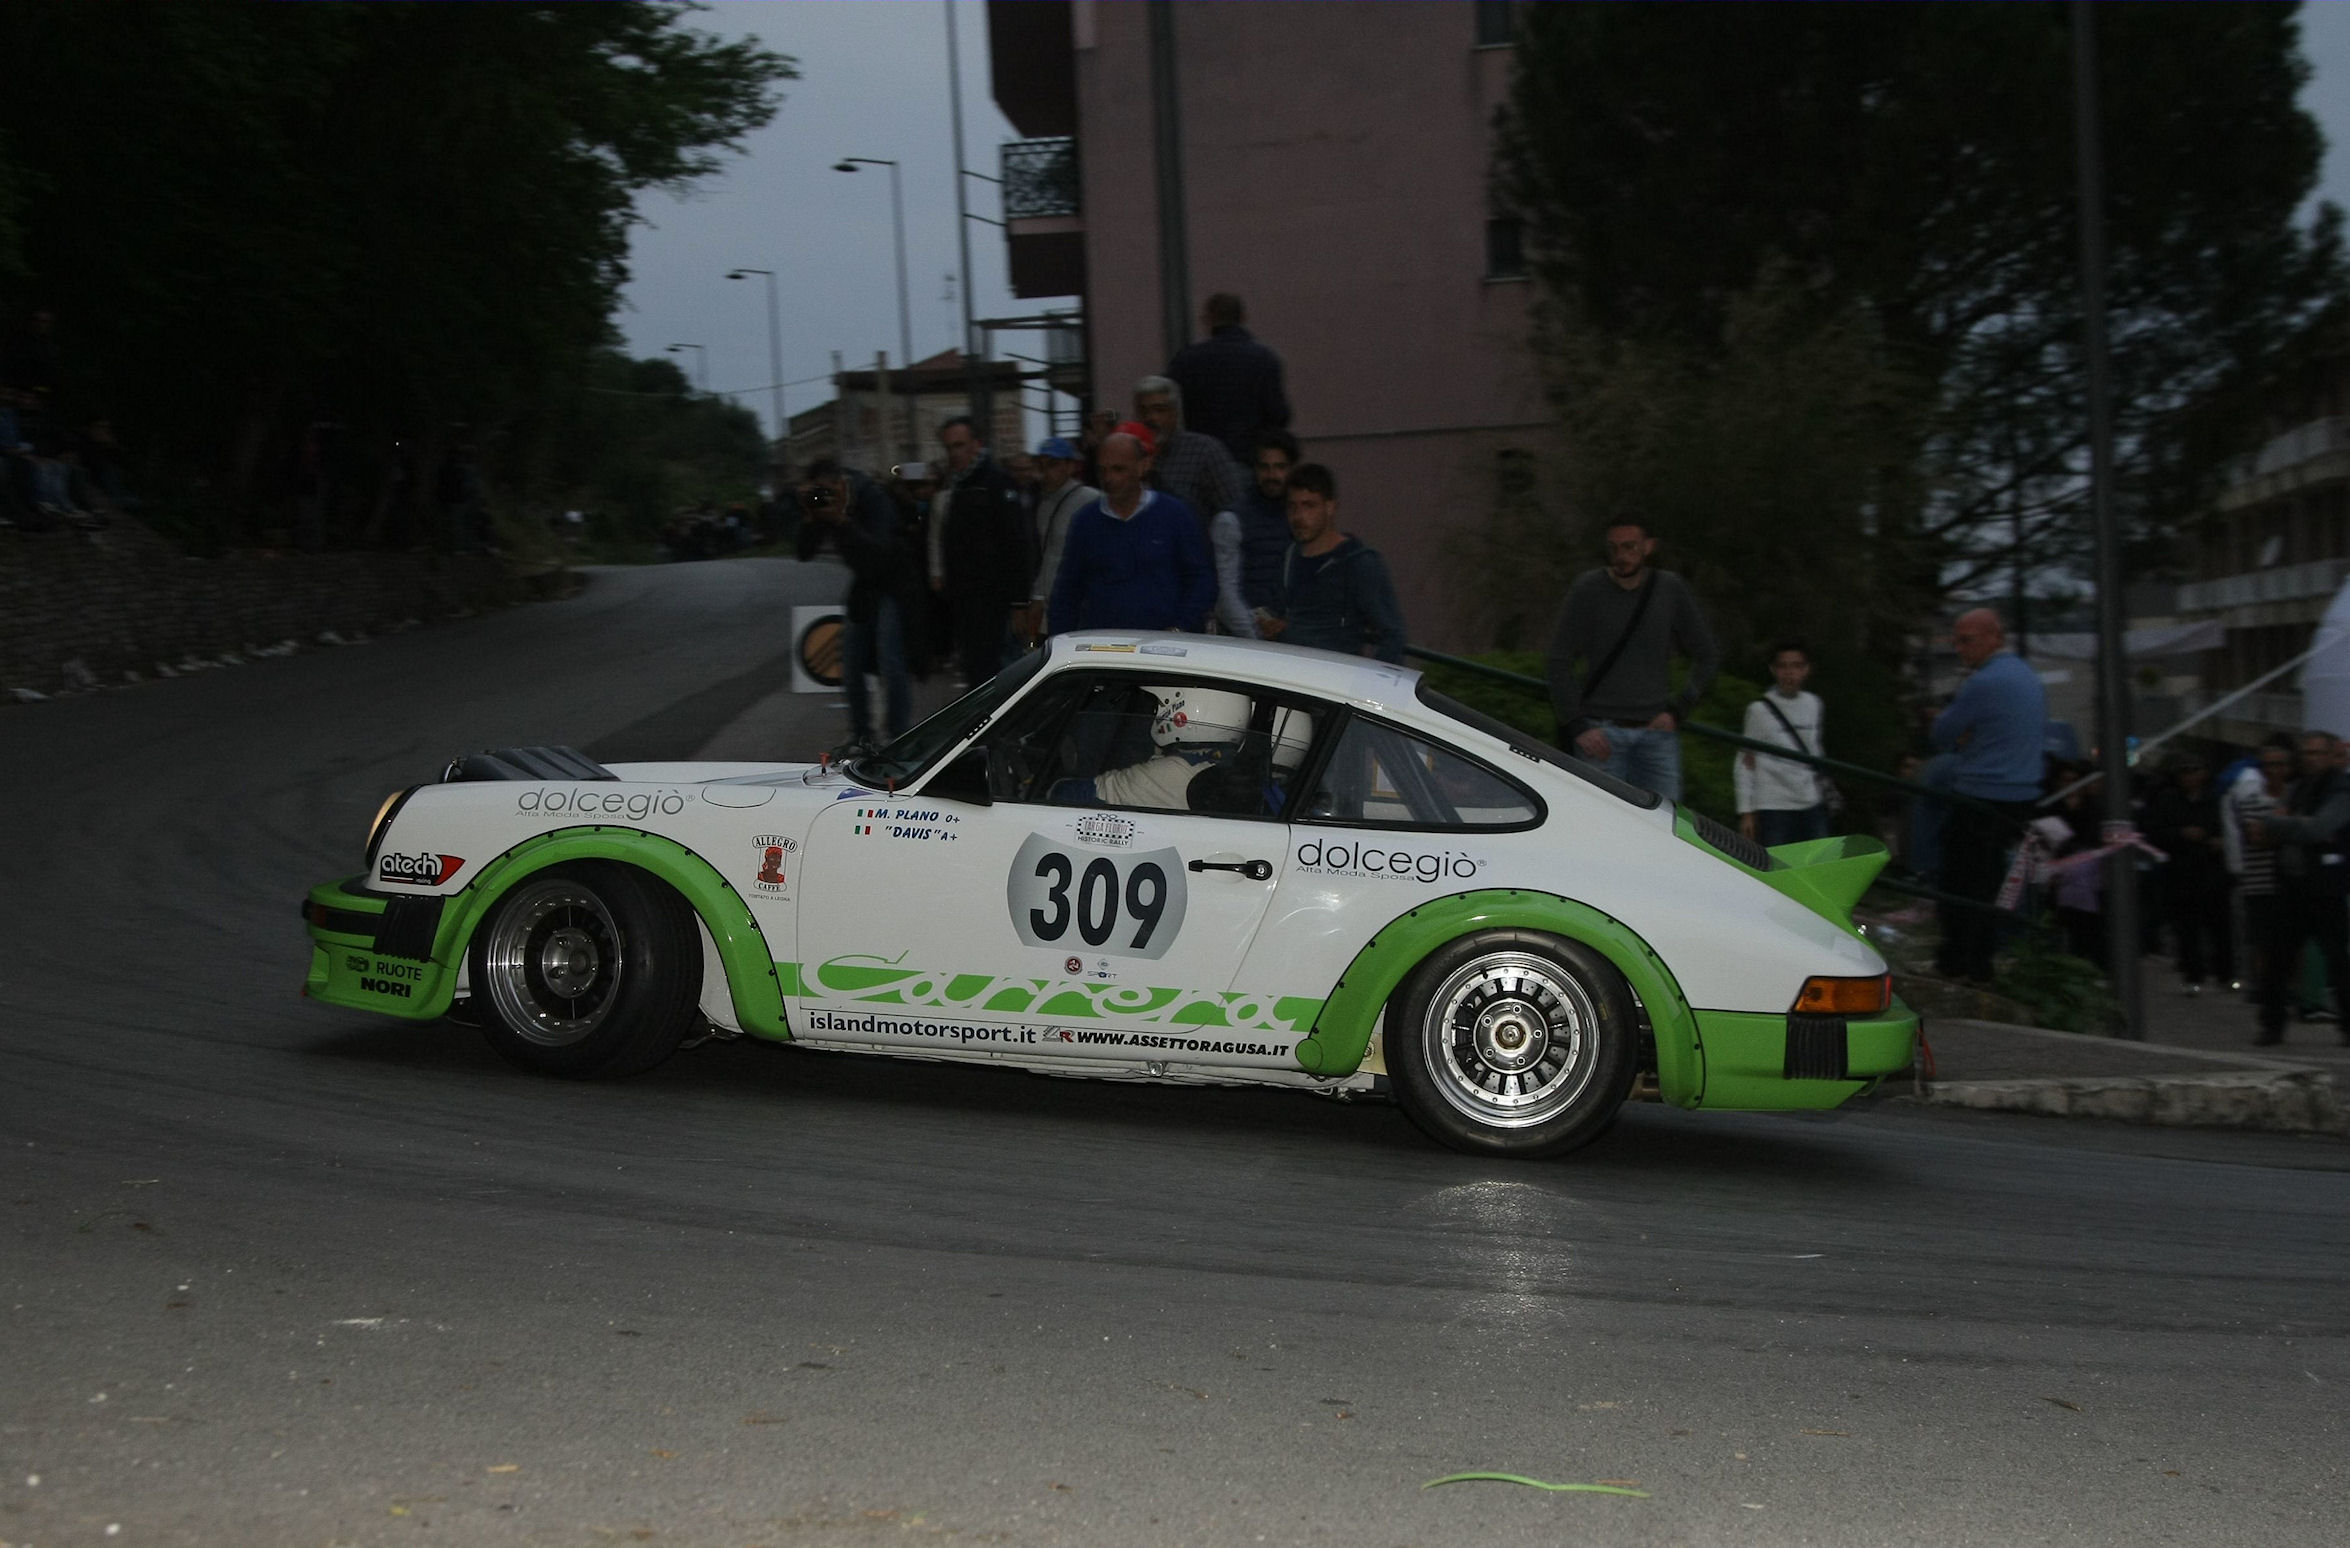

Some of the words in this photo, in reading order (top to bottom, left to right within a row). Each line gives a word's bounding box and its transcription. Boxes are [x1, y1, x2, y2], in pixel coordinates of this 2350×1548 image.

[584, 812, 625, 820] Sposa
[874, 808, 890, 819] M.
[895, 809, 939, 822] PLANO
[1084, 820, 1104, 832] TARGA
[1105, 822, 1129, 834] FLORIO
[755, 836, 796, 851] ALLEGRO
[1077, 836, 1108, 844] HISTORIC
[1109, 838, 1129, 846] RALLY
[381, 853, 438, 876] atech
[1295, 865, 1322, 874] Alta
[1326, 868, 1366, 878] Moda
[1370, 872, 1415, 882] Sposa
[1030, 852, 1168, 950] 309
[376, 961, 423, 981] RUOTE
[361, 977, 412, 998] NORI
[800, 949, 1303, 1031] Carrera
[809, 1011, 1037, 1044] islandmotorsport.it
[1077, 1031, 1290, 1057] WWW.ASSETTORAGUSA.IT
